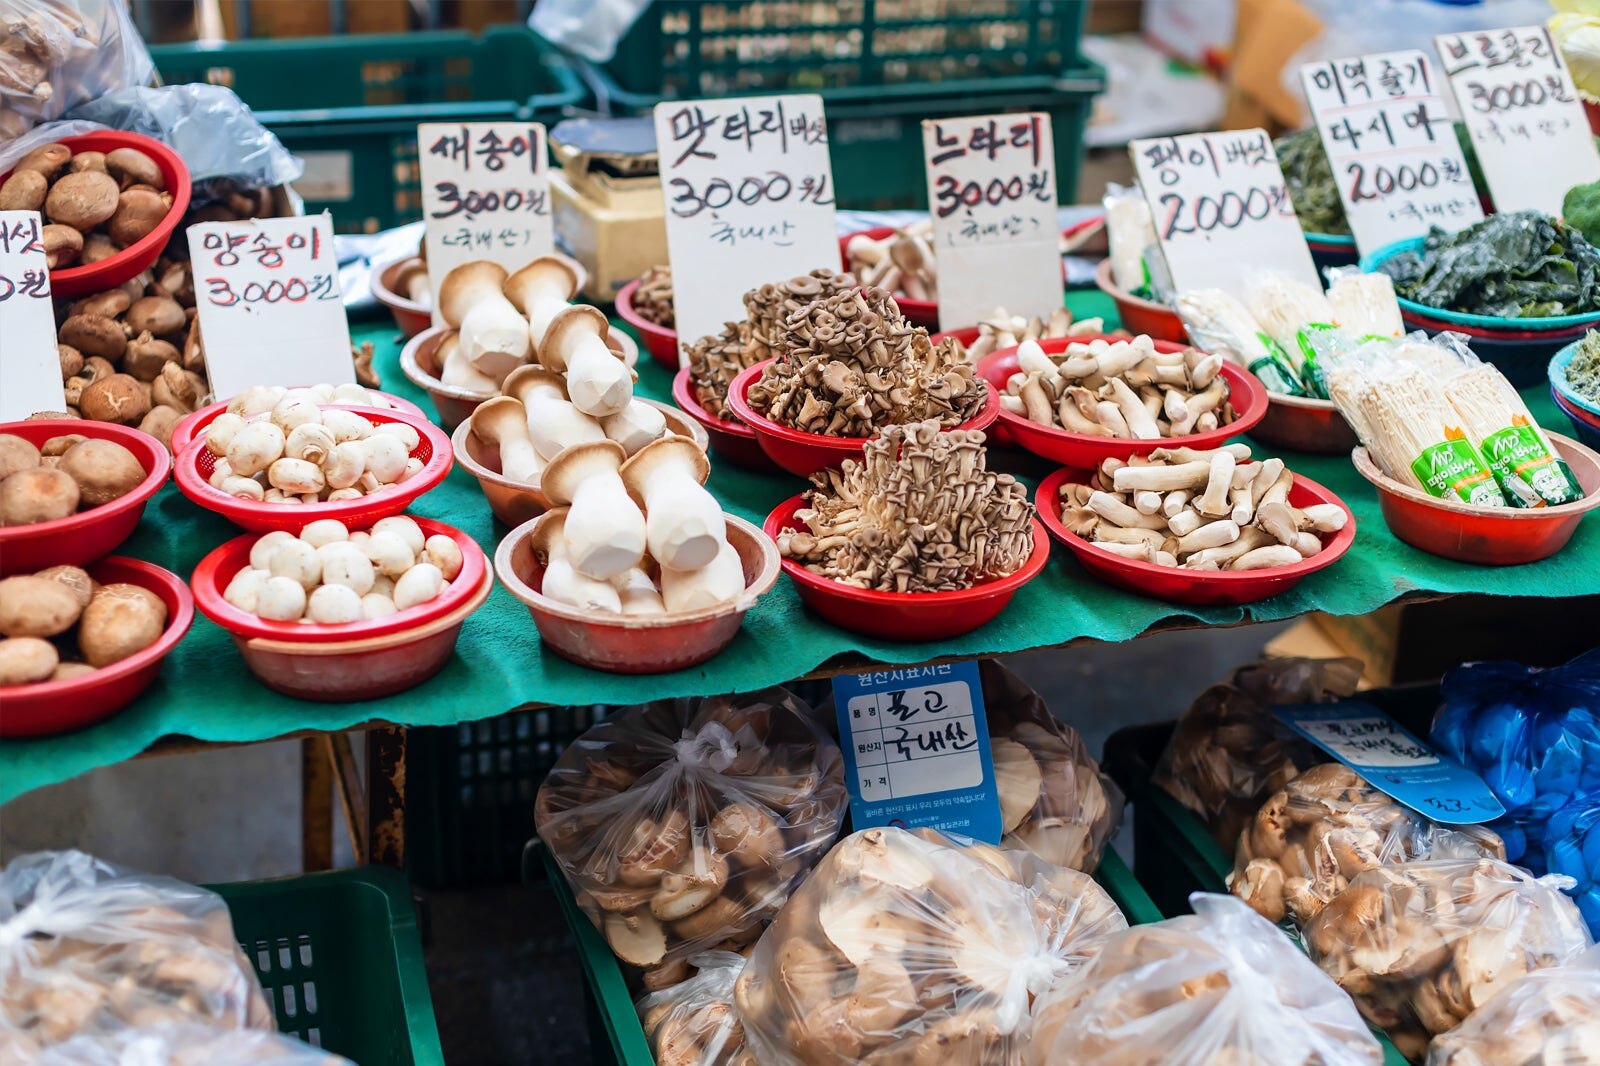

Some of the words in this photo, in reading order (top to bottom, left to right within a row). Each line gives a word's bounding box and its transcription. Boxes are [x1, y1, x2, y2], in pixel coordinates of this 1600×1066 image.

[932, 116, 1041, 167] 느타리
[1329, 103, 1449, 149] 다시마
[430, 126, 538, 174] 새송이
[203, 226, 321, 269] 양송이
[709, 220, 796, 246] 국내산
[857, 742, 882, 754] 원산지
[884, 721, 977, 761] 국내산
[885, 805, 904, 815] 원산지
[919, 801, 932, 810] 우리
